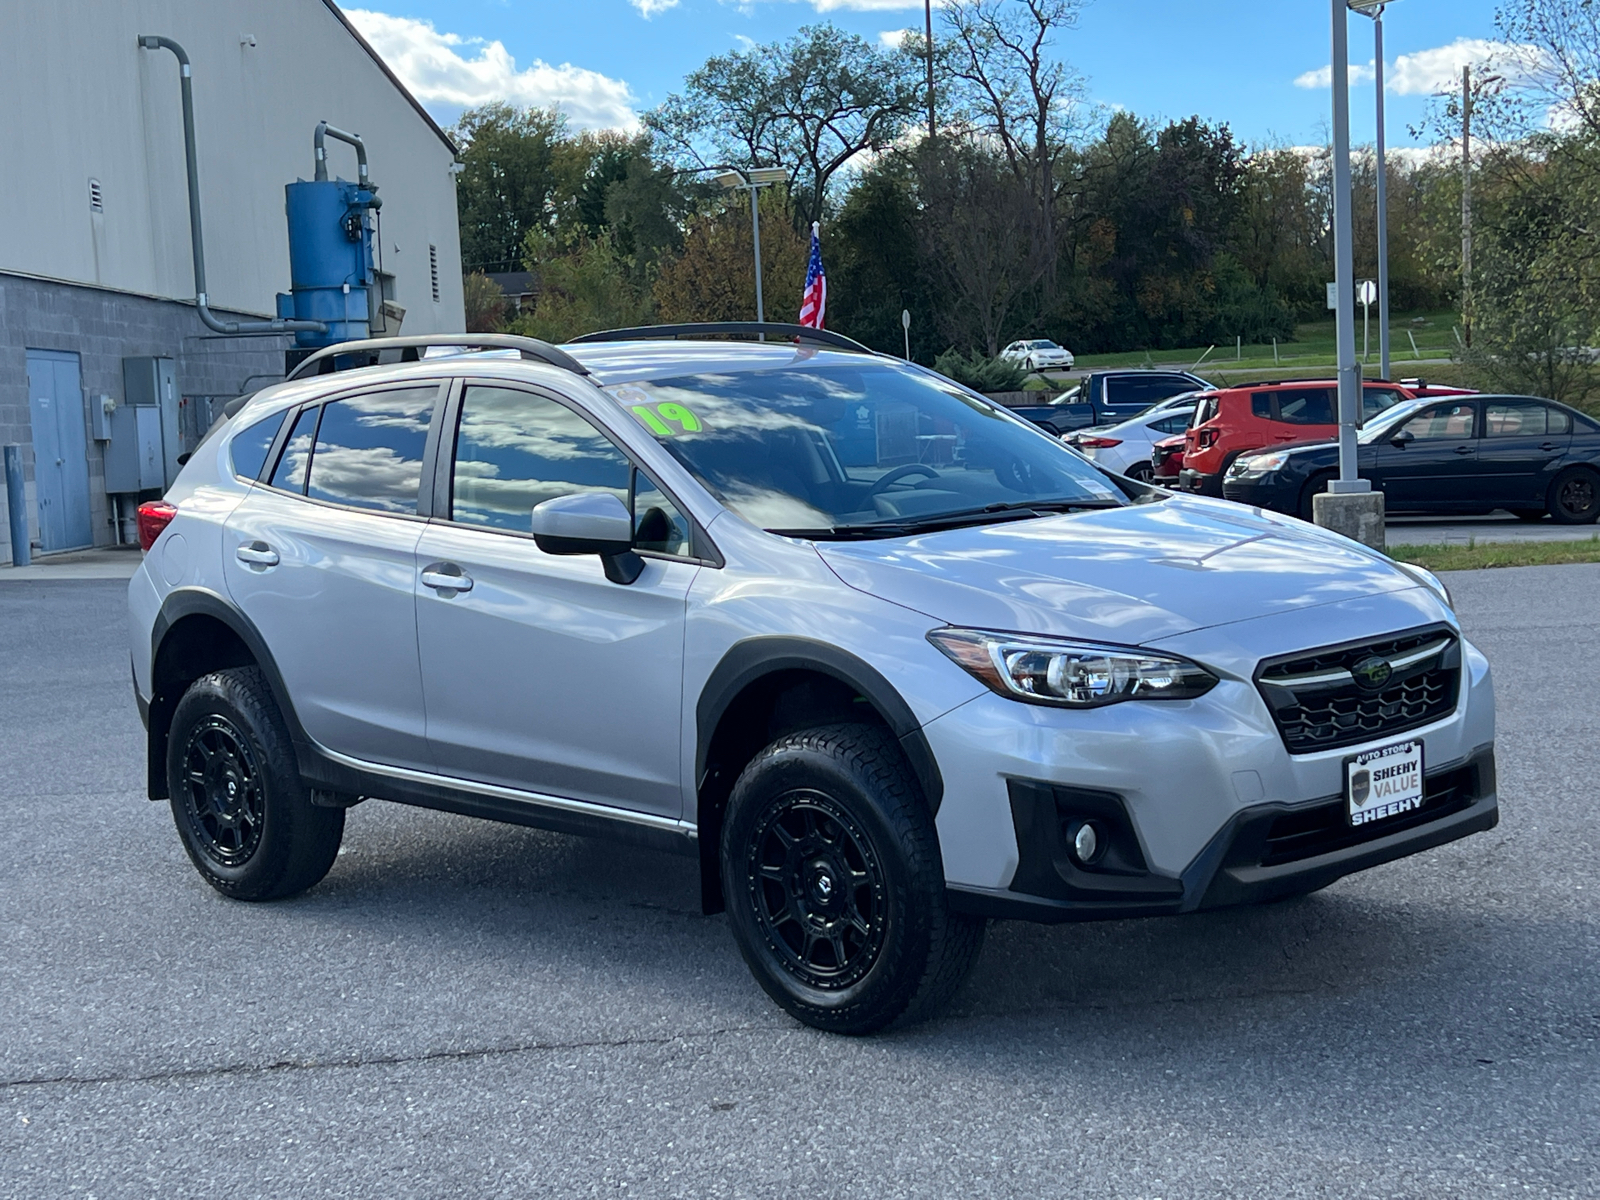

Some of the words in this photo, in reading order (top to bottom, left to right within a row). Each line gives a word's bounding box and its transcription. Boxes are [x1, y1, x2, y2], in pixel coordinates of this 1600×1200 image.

[631, 402, 703, 435] 19
[1356, 751, 1381, 764] AUTO
[1373, 760, 1418, 782] SHEEHY
[1374, 773, 1419, 798] VALUE
[1351, 795, 1423, 826] SHEEHY
